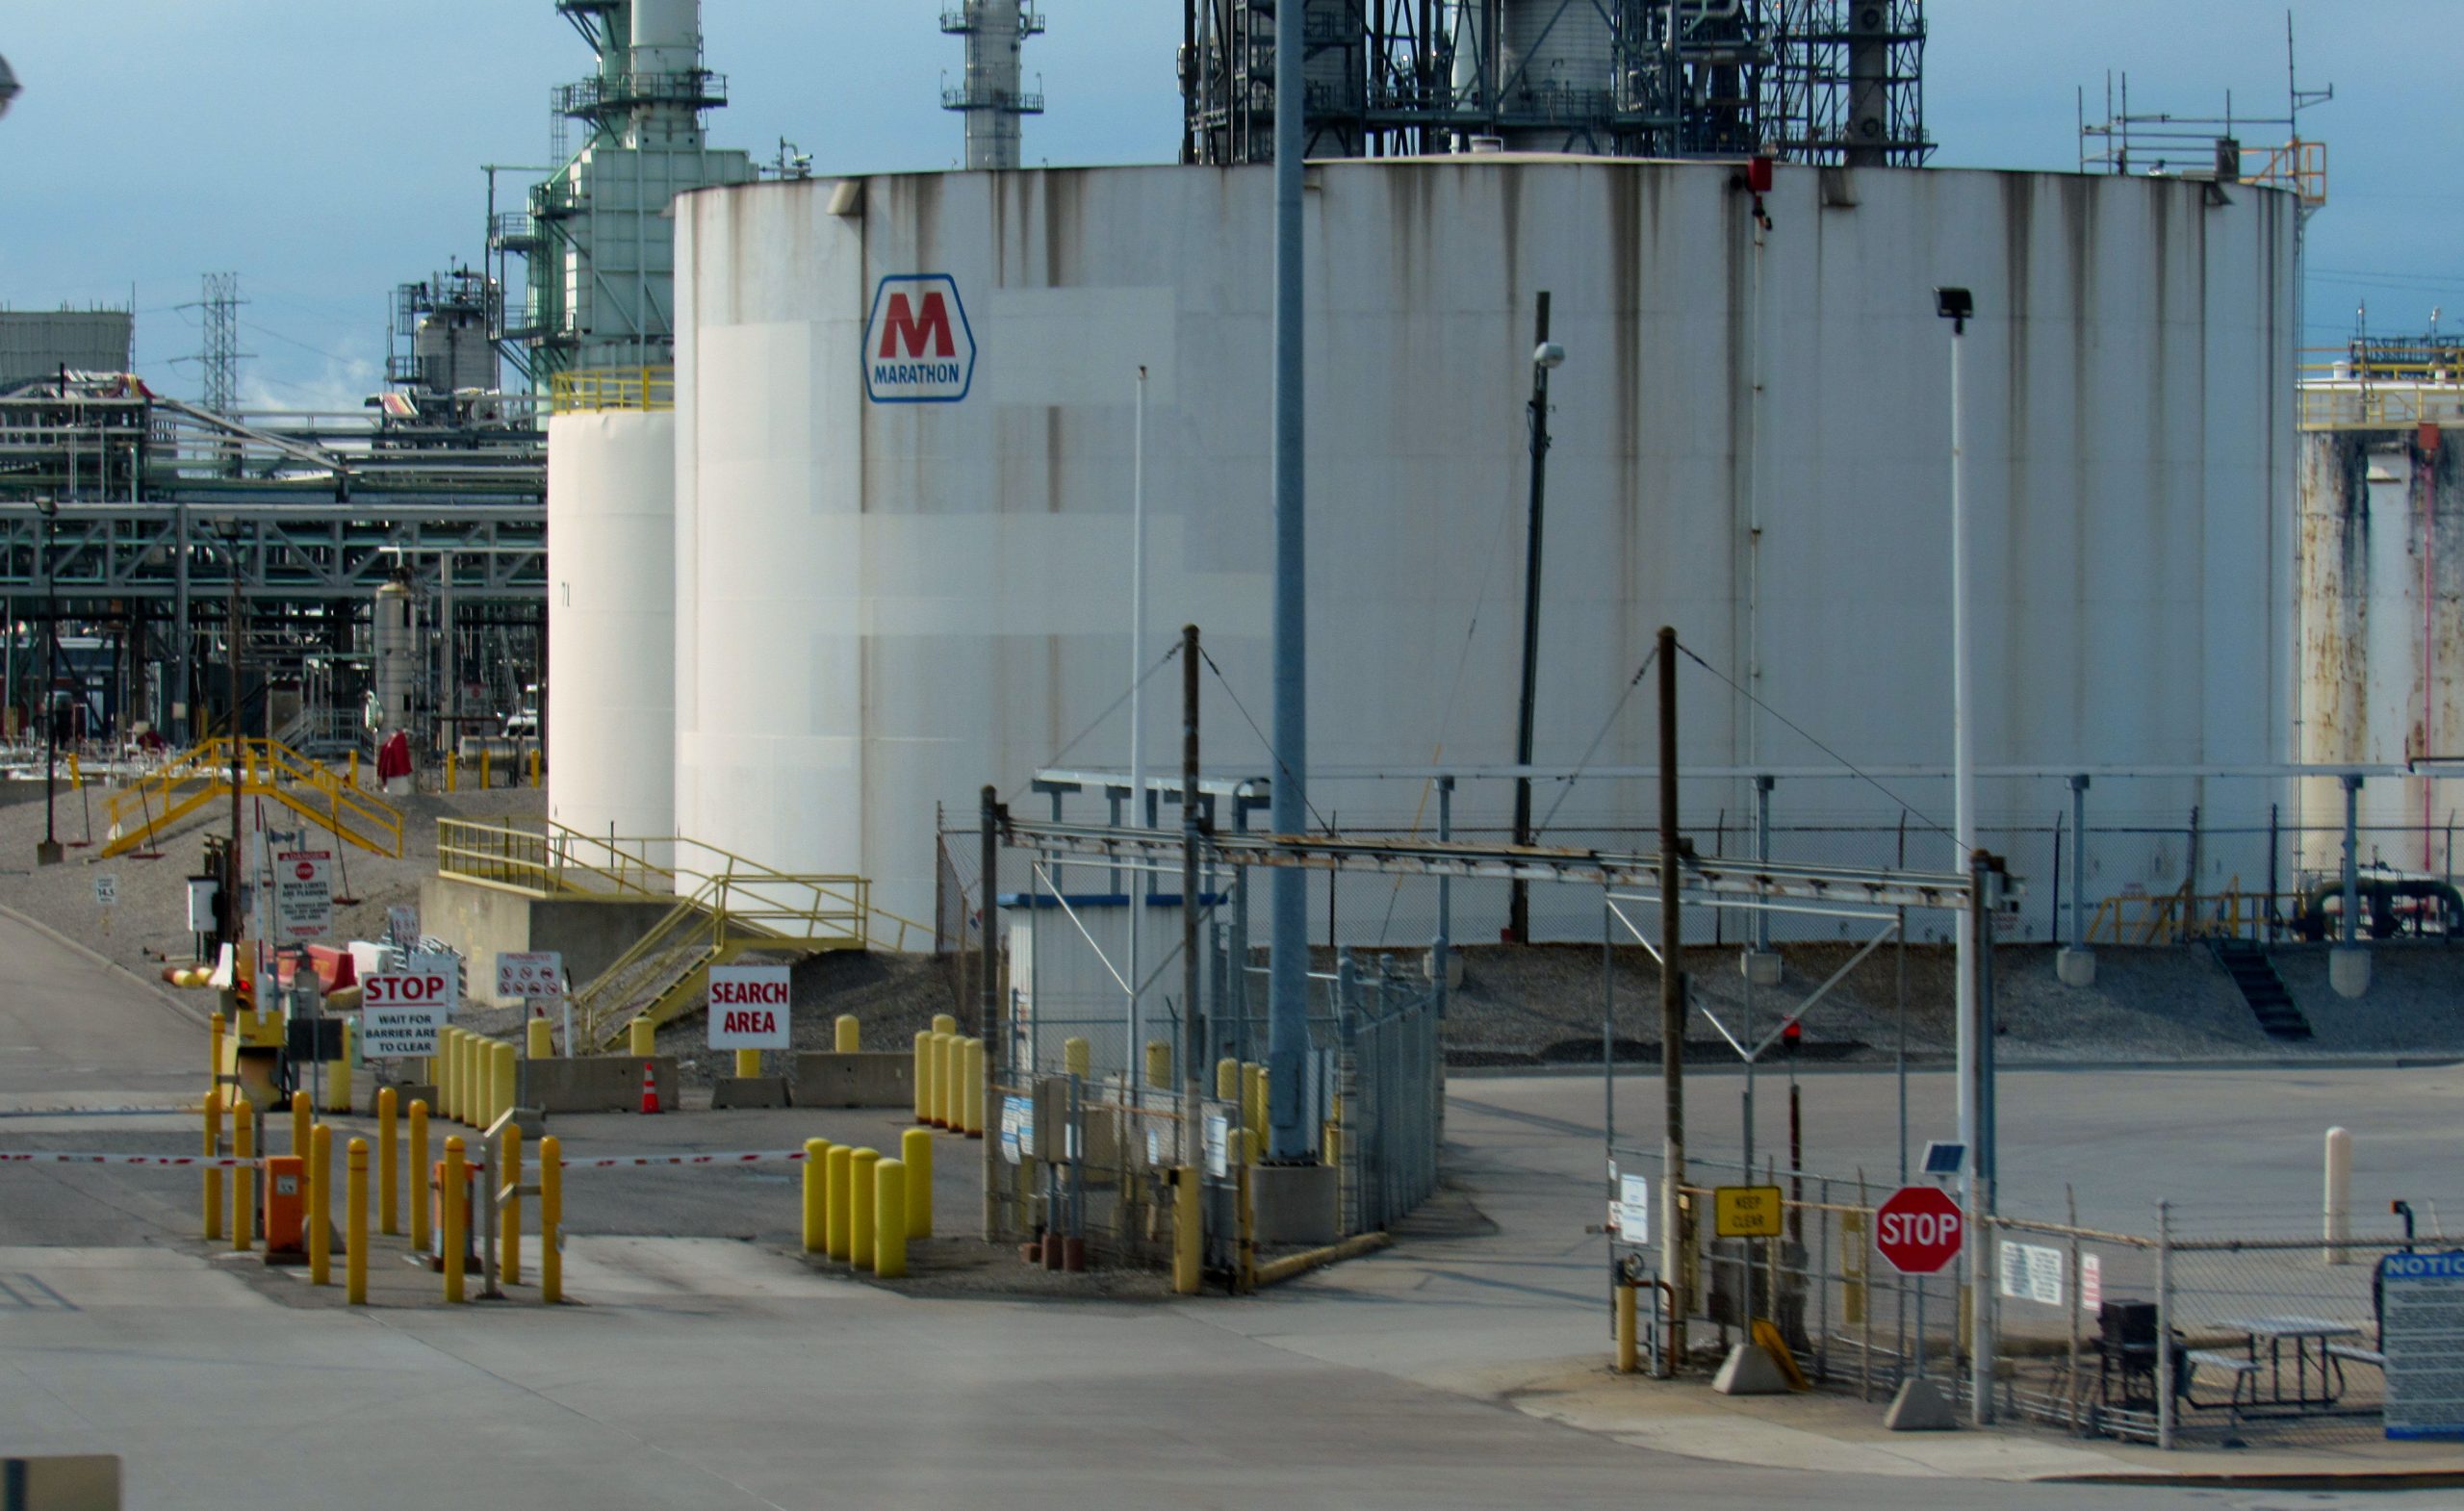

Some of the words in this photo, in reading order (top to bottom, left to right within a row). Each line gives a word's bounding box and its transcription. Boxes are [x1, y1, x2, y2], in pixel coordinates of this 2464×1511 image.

[878, 292, 957, 359] M
[874, 364, 960, 384] MARATHON
[366, 976, 445, 1001] STOP
[711, 982, 787, 1003] SEARCH
[378, 1014, 406, 1024] WAIT
[409, 1014, 431, 1024] FOR
[724, 1012, 777, 1033] AREA
[366, 1029, 413, 1038] BARRIER
[415, 1028, 438, 1037] ARE
[379, 1042, 394, 1052] TO
[397, 1041, 431, 1052] CLEAR
[1734, 1195, 1762, 1210] KEEP
[1732, 1215, 1765, 1228] CLEAR
[1881, 1212, 1959, 1245] STOP
